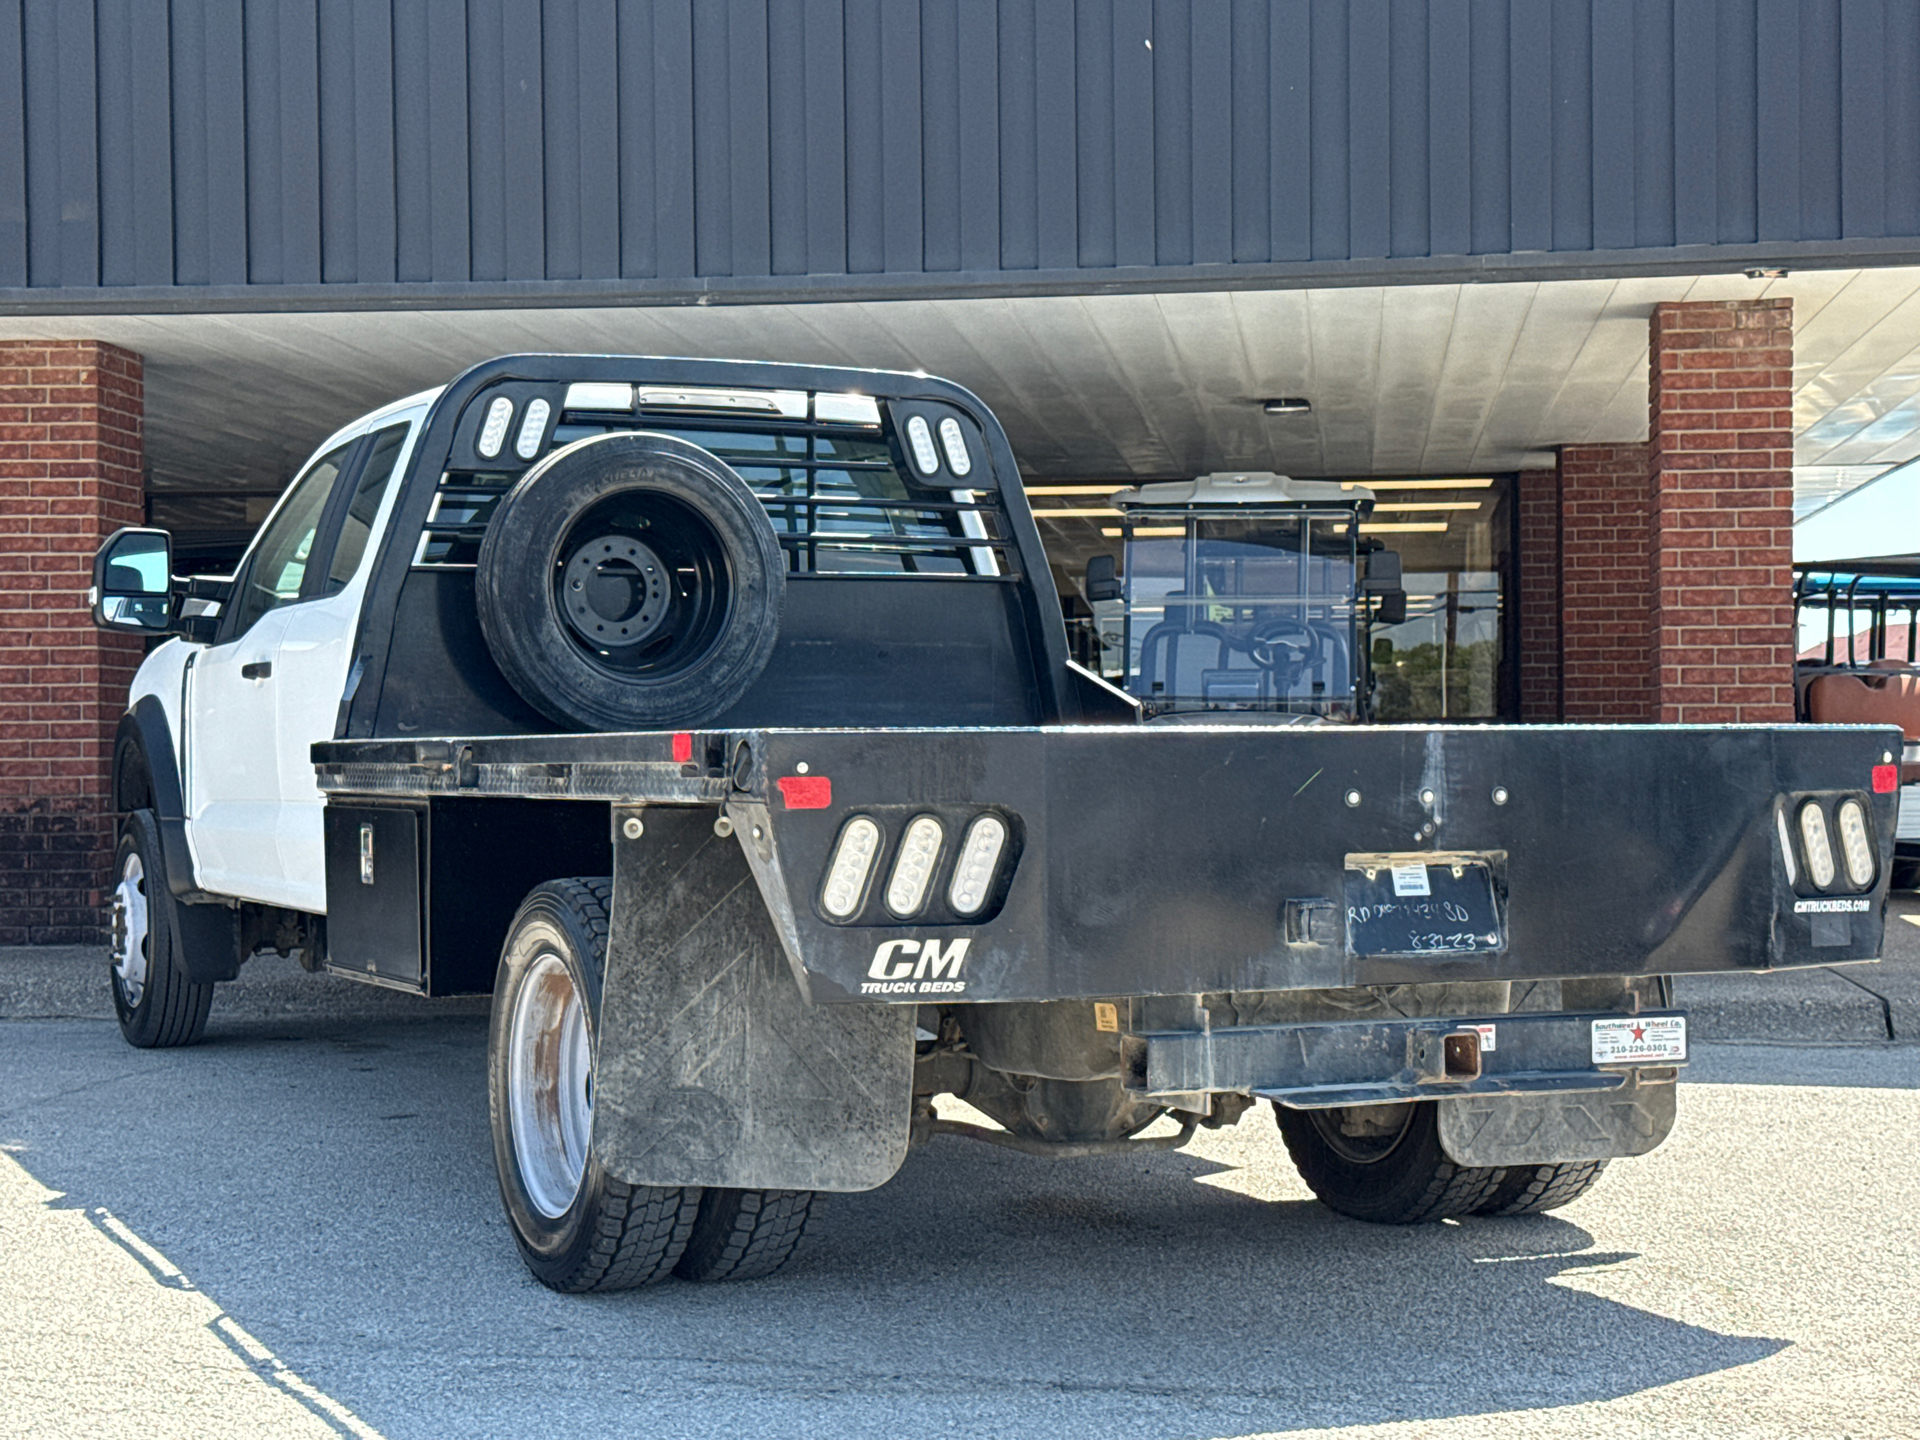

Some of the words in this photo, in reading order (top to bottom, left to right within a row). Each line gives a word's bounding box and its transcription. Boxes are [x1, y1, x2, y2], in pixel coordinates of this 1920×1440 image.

[1794, 900, 1870, 913] CMTRUCKBEDS.COM
[867, 938, 972, 980] CM
[861, 982, 917, 994] TRUCK
[919, 981, 966, 993] BEDS
[1595, 1022, 1634, 1031] Southwest
[1645, 1020, 1668, 1028] Wheel
